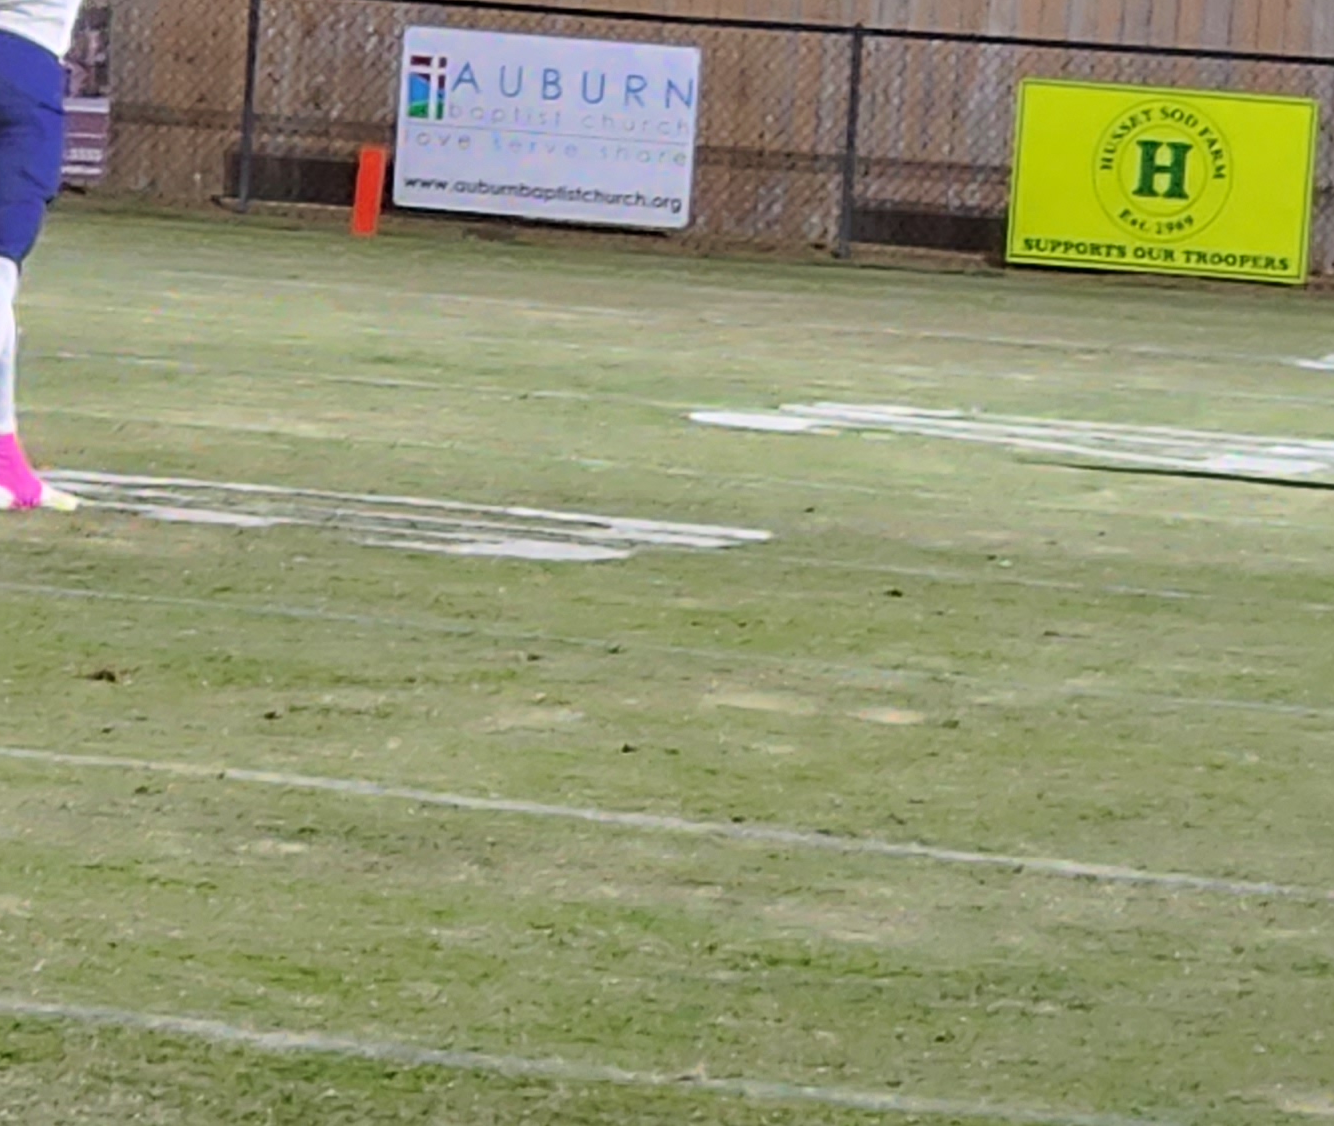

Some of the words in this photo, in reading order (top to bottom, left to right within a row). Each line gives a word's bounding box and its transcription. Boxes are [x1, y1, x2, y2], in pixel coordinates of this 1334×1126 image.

[451, 61, 694, 110] AUBURN
[449, 102, 562, 124] baptist
[581, 111, 689, 136] church
[1159, 105, 1199, 129] SOD
[1131, 138, 1194, 201] H
[1023, 238, 1127, 260] SUPPORTS
[1133, 247, 1177, 264] OUR
[1183, 250, 1290, 272] TROOPERS
